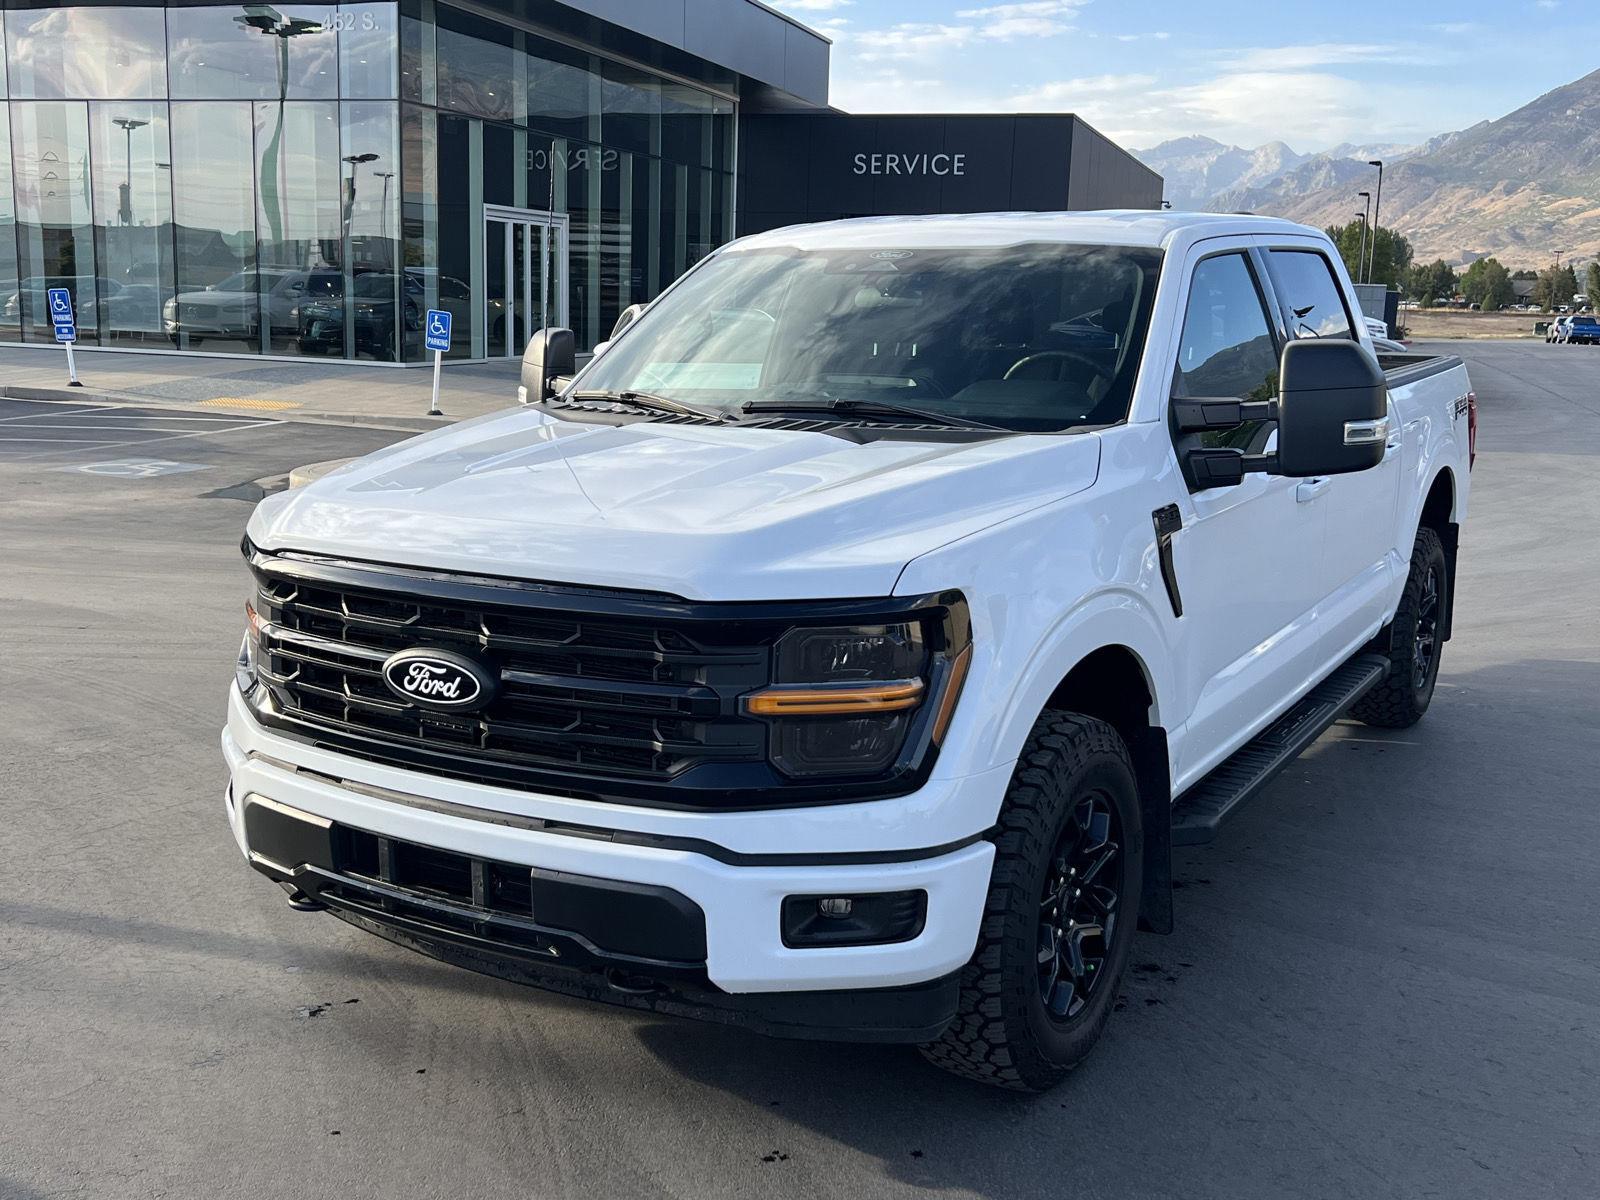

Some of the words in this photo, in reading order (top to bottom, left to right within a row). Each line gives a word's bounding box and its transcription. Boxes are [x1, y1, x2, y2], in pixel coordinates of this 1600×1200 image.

[322, 12, 356, 31] 452
[362, 12, 380, 31] S.
[853, 153, 966, 175] SERVICE
[428, 337, 448, 347] PARKING
[403, 662, 462, 698] Ford
